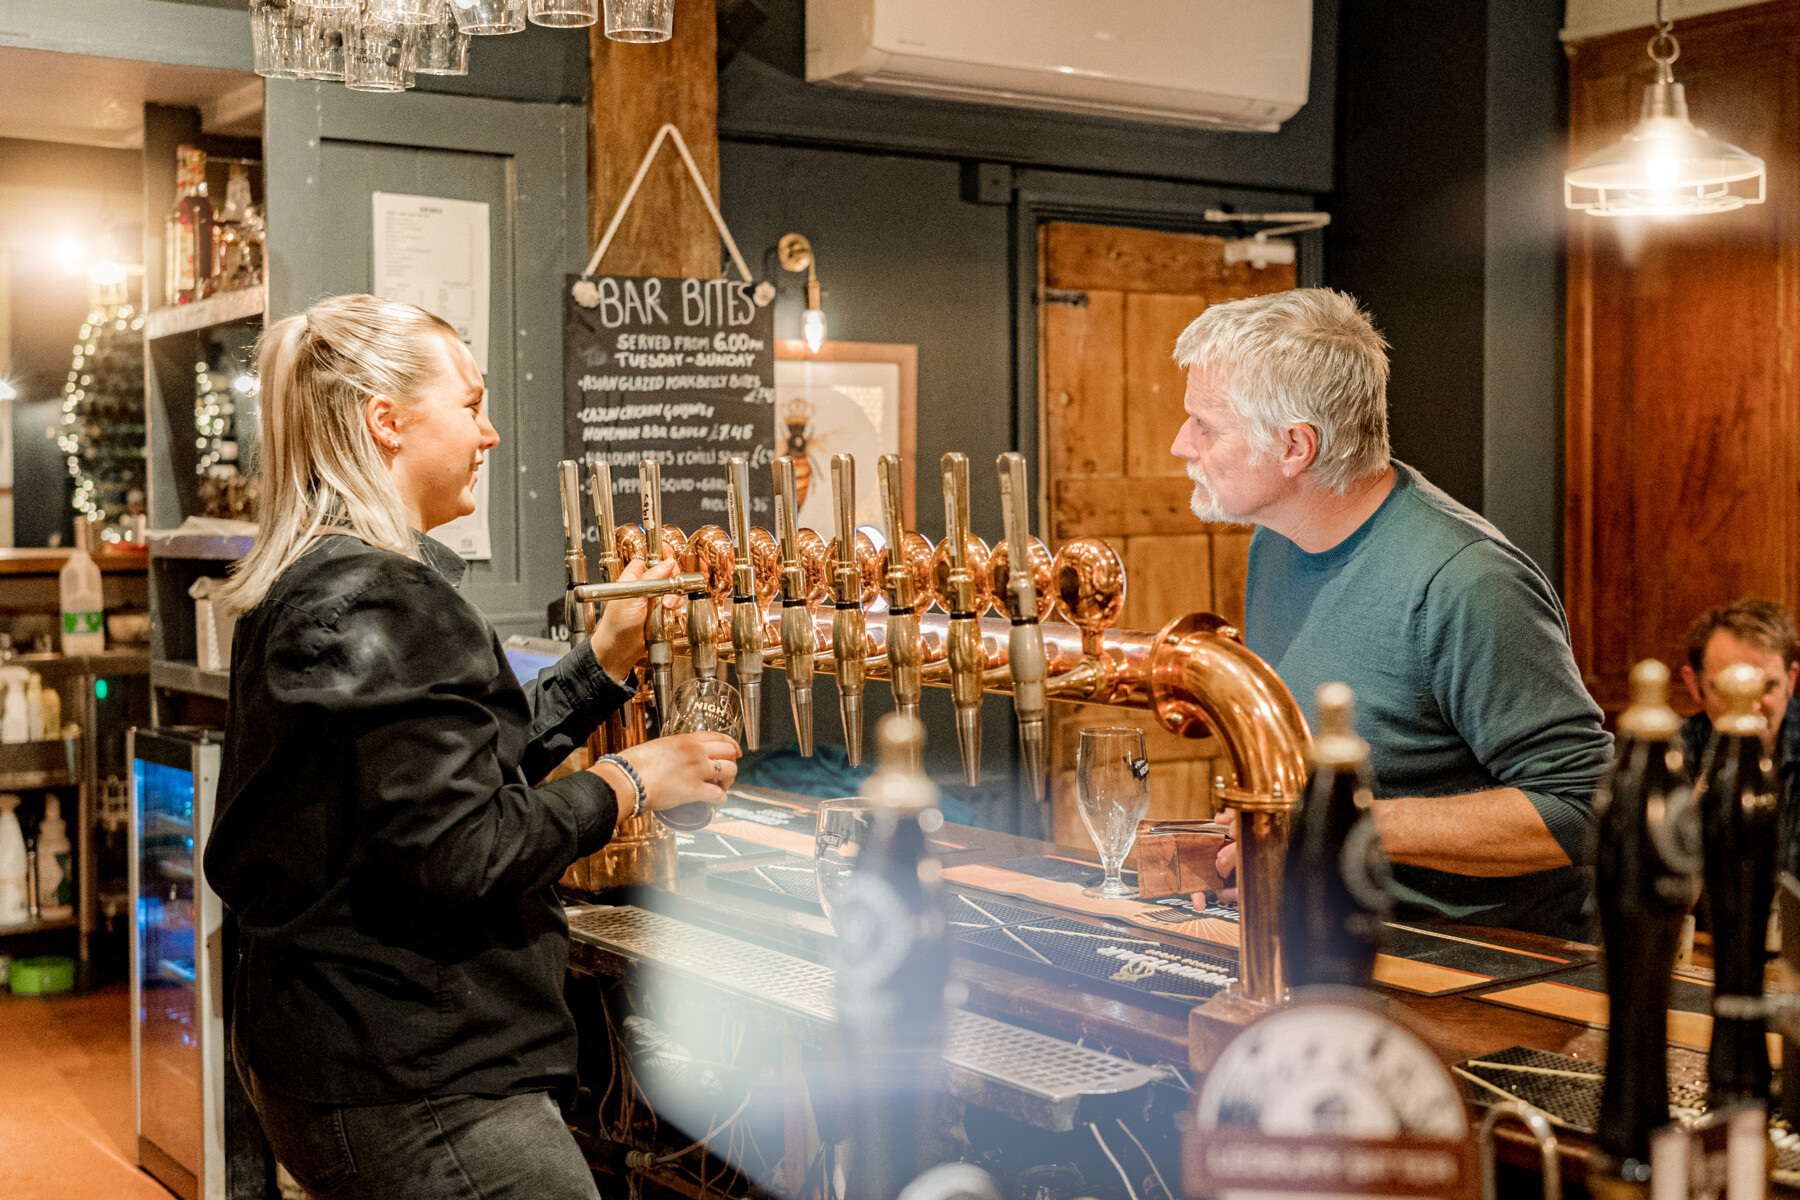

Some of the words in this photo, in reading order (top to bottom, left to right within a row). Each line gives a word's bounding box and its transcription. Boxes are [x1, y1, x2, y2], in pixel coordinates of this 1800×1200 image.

[598, 277, 669, 328] BAR
[681, 277, 756, 327] BITES
[616, 333, 672, 351] SERVED
[674, 335, 710, 351] FROM
[618, 375, 665, 392] GLAZED
[581, 406, 620, 423] CAJUN
